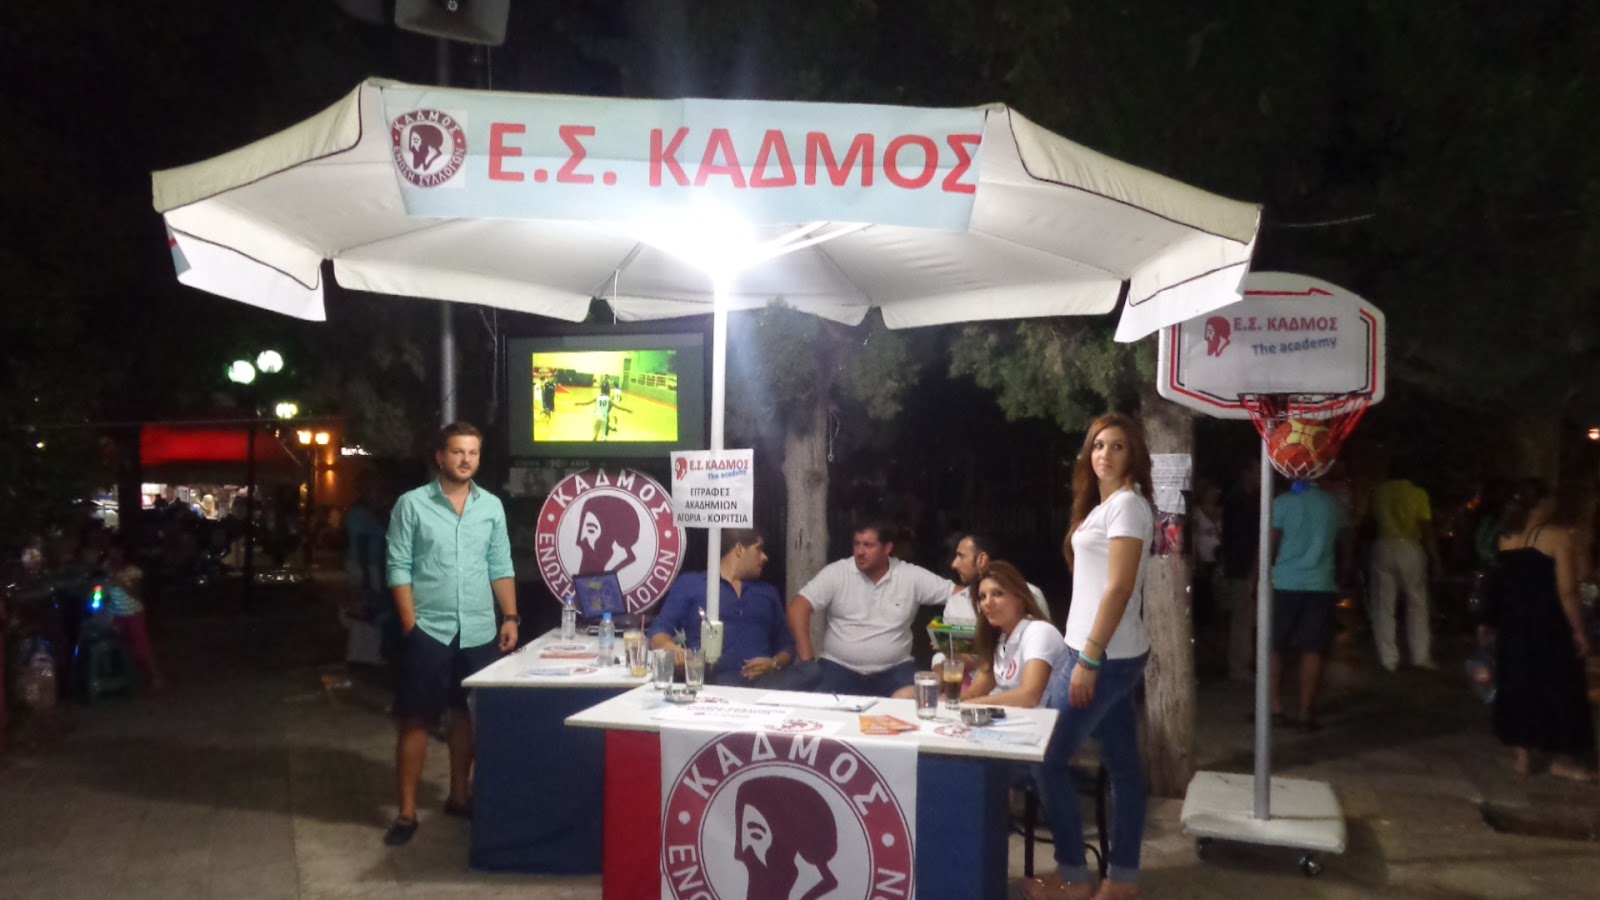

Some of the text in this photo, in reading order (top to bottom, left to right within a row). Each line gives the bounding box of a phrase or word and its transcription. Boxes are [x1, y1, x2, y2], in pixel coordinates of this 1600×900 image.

[393, 110, 460, 135] ΚΑΔΜΟΣ
[488, 122, 981, 194] Ε.Σ. ΚΑΔΜΟΣ
[1233, 316, 1338, 331] Ε.Σ. ΚΑΔΜΟΣ
[1252, 337, 1337, 356] The academy
[689, 459, 749, 471] Ε.Σ. ΚΑΔΜΟΣ
[707, 472, 719, 480] The
[552, 467, 671, 520] ΚΑΔΜΟΣ
[690, 487, 730, 497] ΕΓΓΡΑΦΕΣ
[685, 500, 737, 510] ΑΚΑΔΗΜΙΩΝ
[677, 513, 701, 522] ΑΓΟΡΙΑ
[708, 513, 748, 523] ΚΟΡΙΤΣΙΑ
[624, 549, 676, 613] ΛΟΓΩΝ
[683, 731, 889, 816] ΚΑΔΜΟΣ
